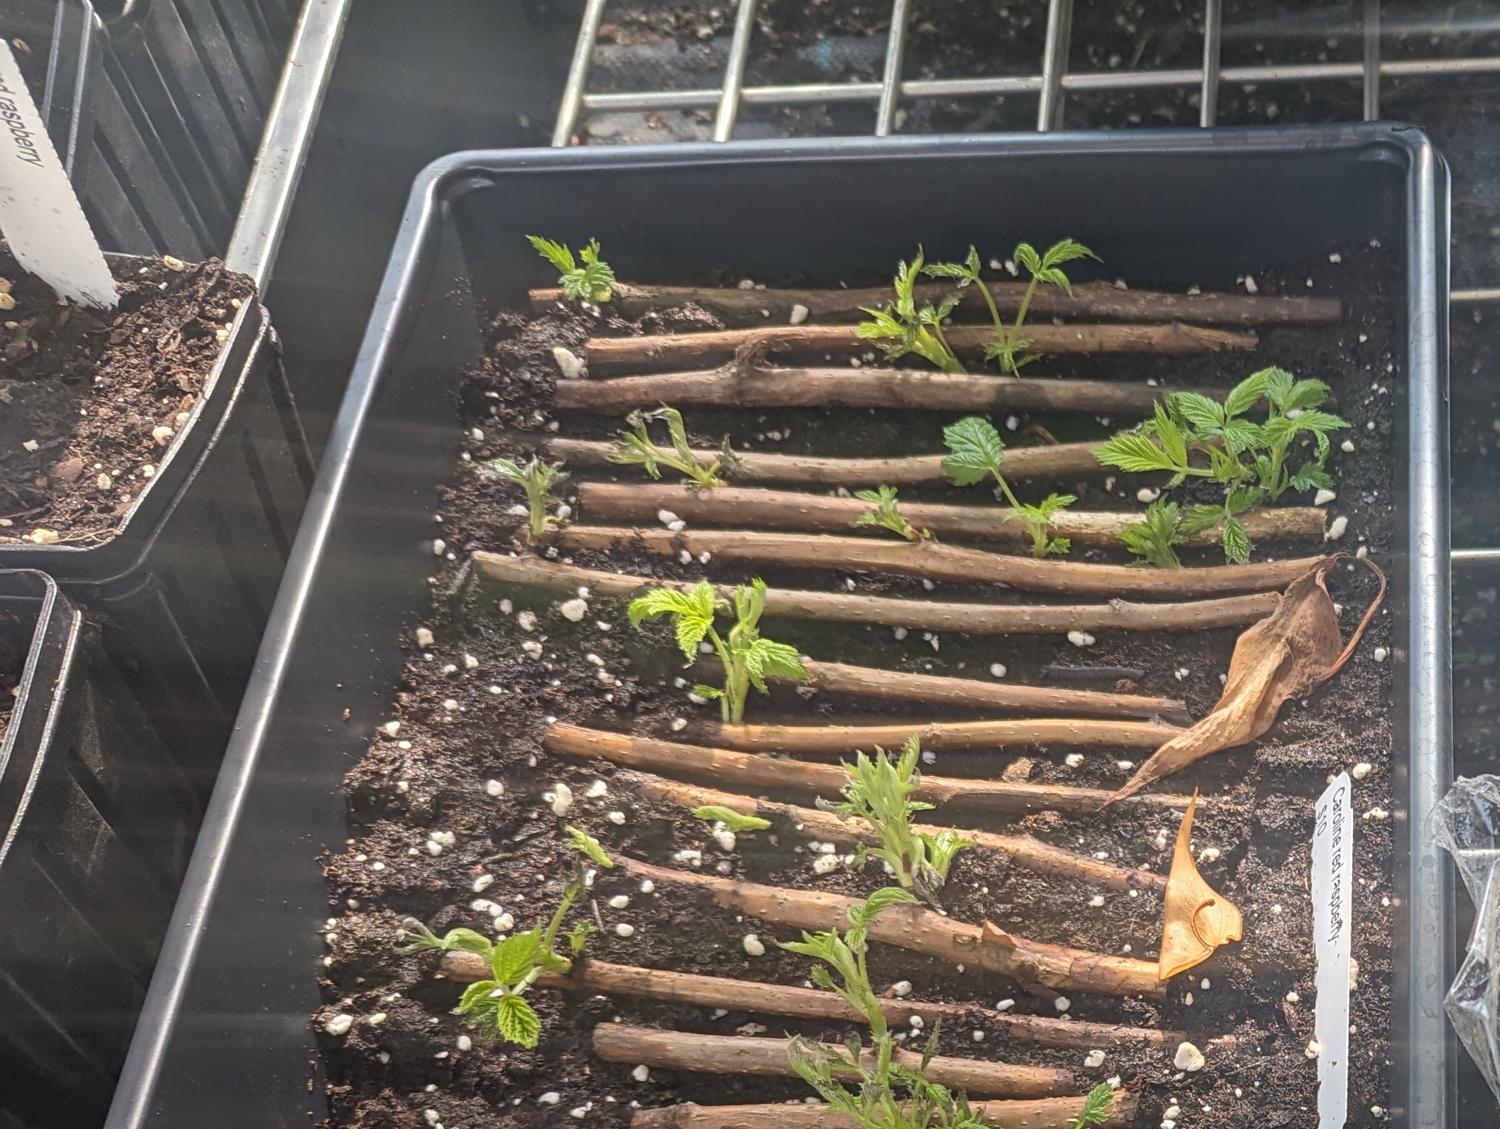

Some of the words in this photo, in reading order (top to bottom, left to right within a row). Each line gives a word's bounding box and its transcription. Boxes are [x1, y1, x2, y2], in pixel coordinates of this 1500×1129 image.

[0, 96, 44, 168] raspberry
[1331, 786, 1346, 848] Caroline
[1331, 847, 1344, 873] red
